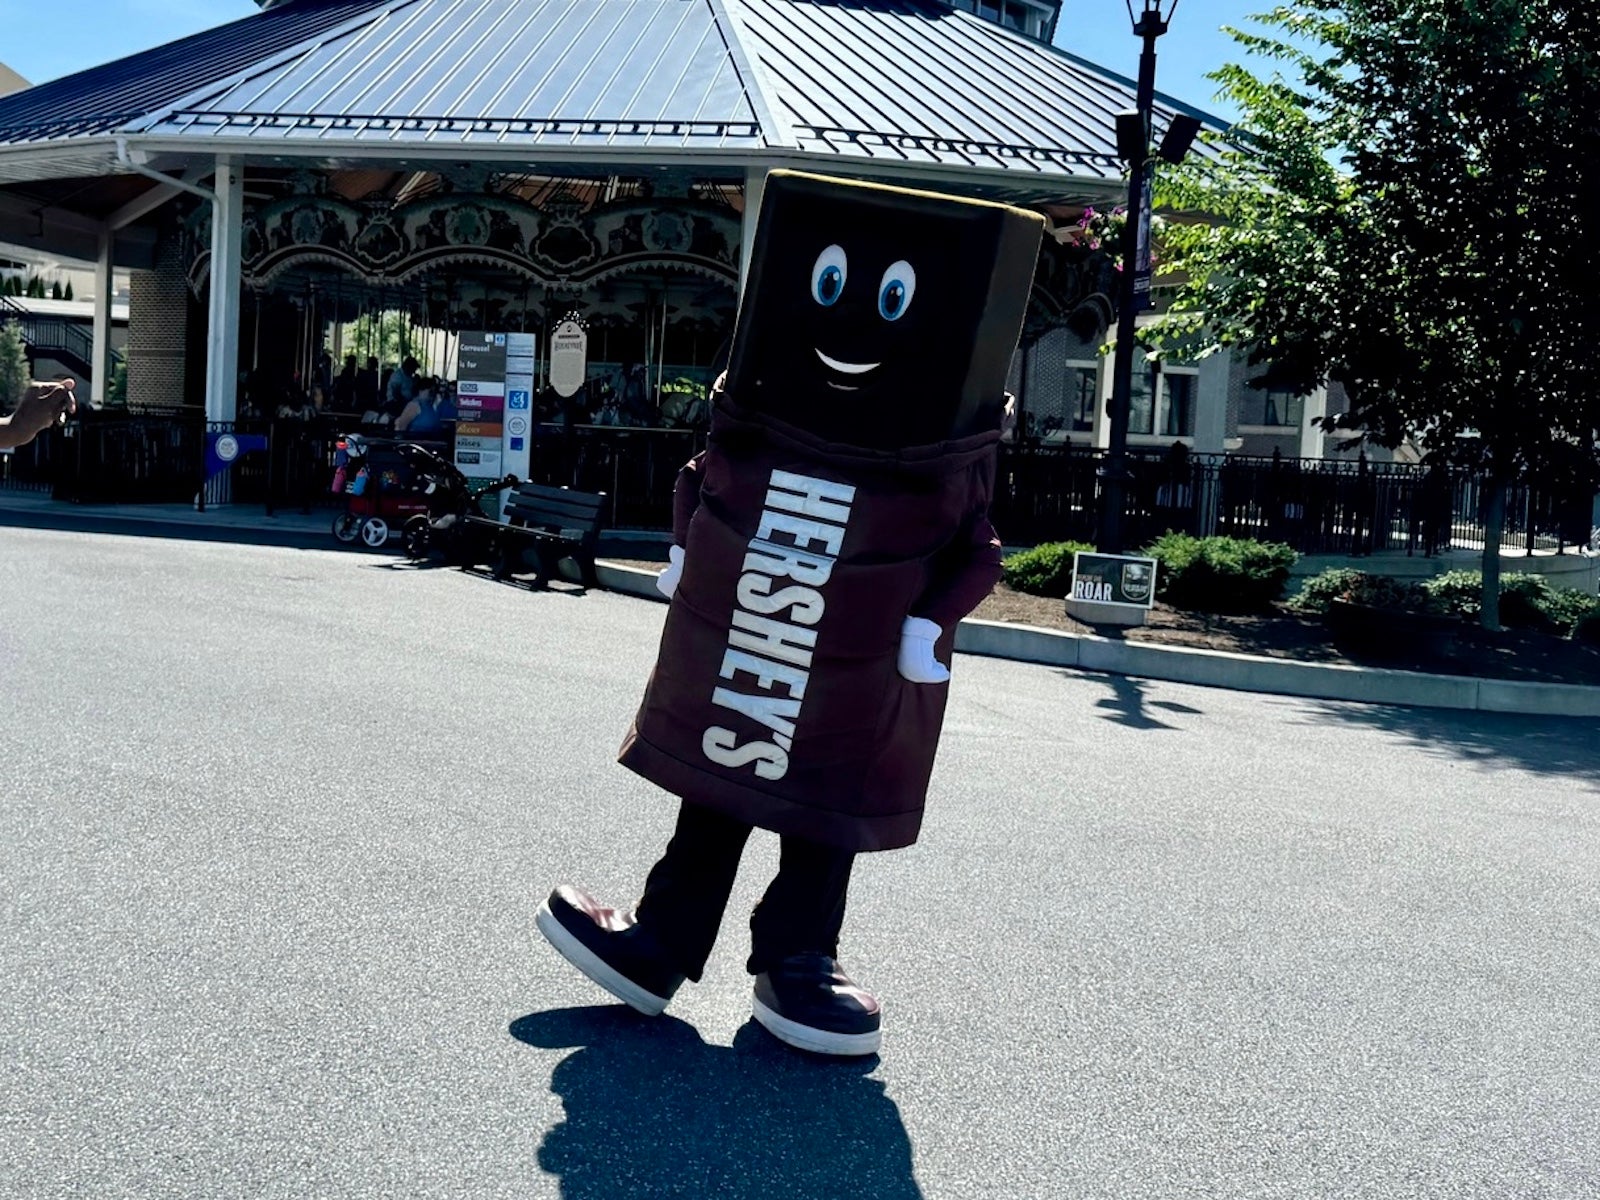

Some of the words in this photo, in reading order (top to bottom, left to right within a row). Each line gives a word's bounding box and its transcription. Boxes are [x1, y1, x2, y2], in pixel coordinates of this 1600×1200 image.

[460, 343, 491, 352] Carrousel
[467, 360, 478, 368] for
[1075, 580, 1113, 601] ROAR
[702, 469, 857, 781] HERSHEY'S
